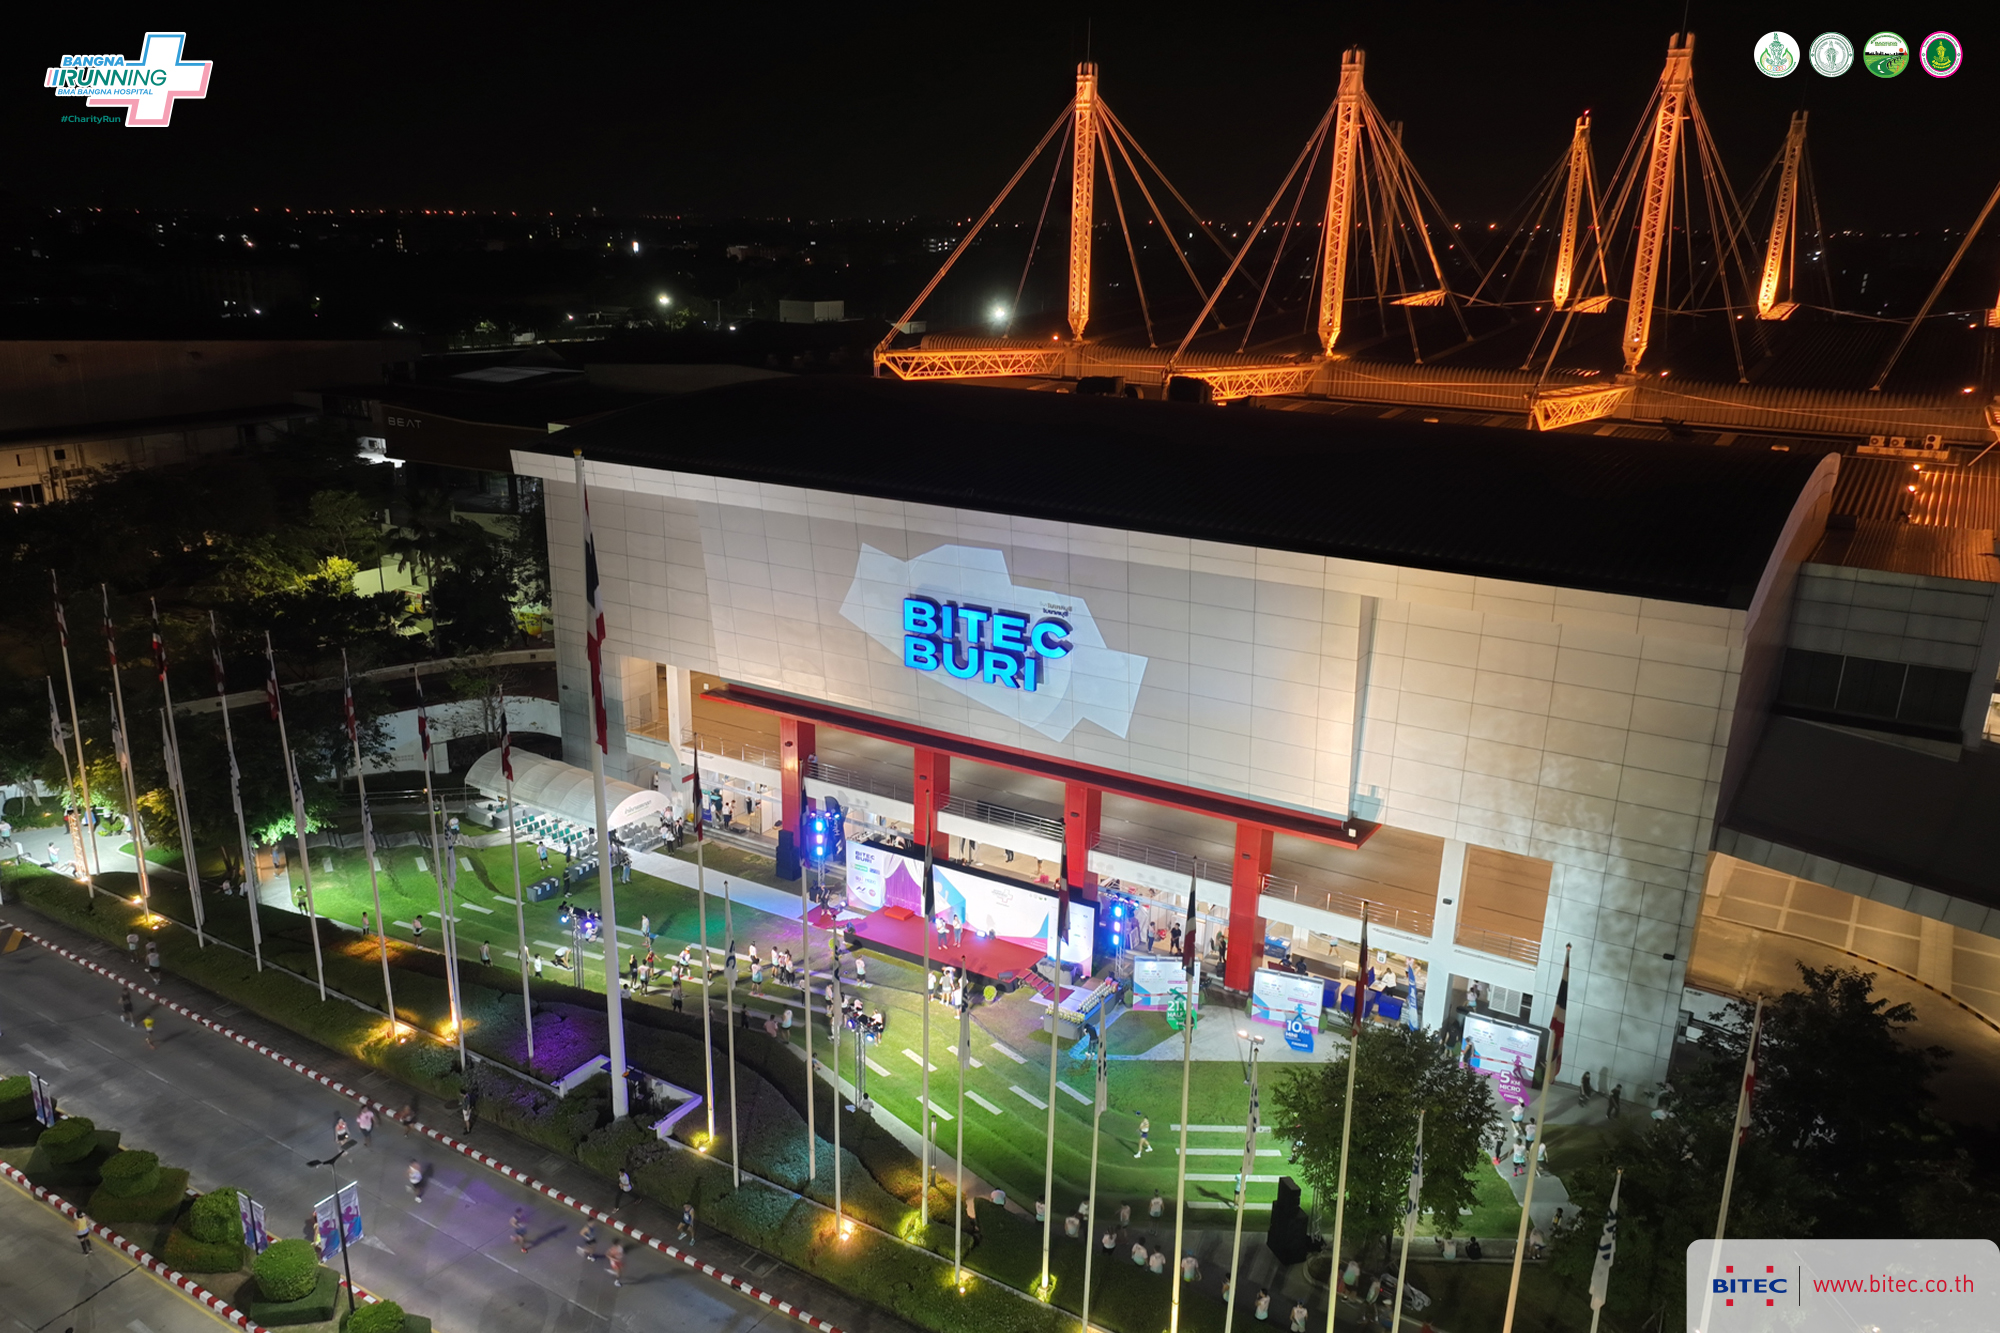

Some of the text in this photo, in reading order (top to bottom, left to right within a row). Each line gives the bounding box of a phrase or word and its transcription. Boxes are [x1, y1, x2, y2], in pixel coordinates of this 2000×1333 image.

[903, 598, 1070, 660] BITEC
[904, 634, 1038, 693] BURI
[1286, 1019, 1303, 1033] 10
[1500, 1071, 1510, 1083] 5
[1499, 1084, 1521, 1093] MICRO
